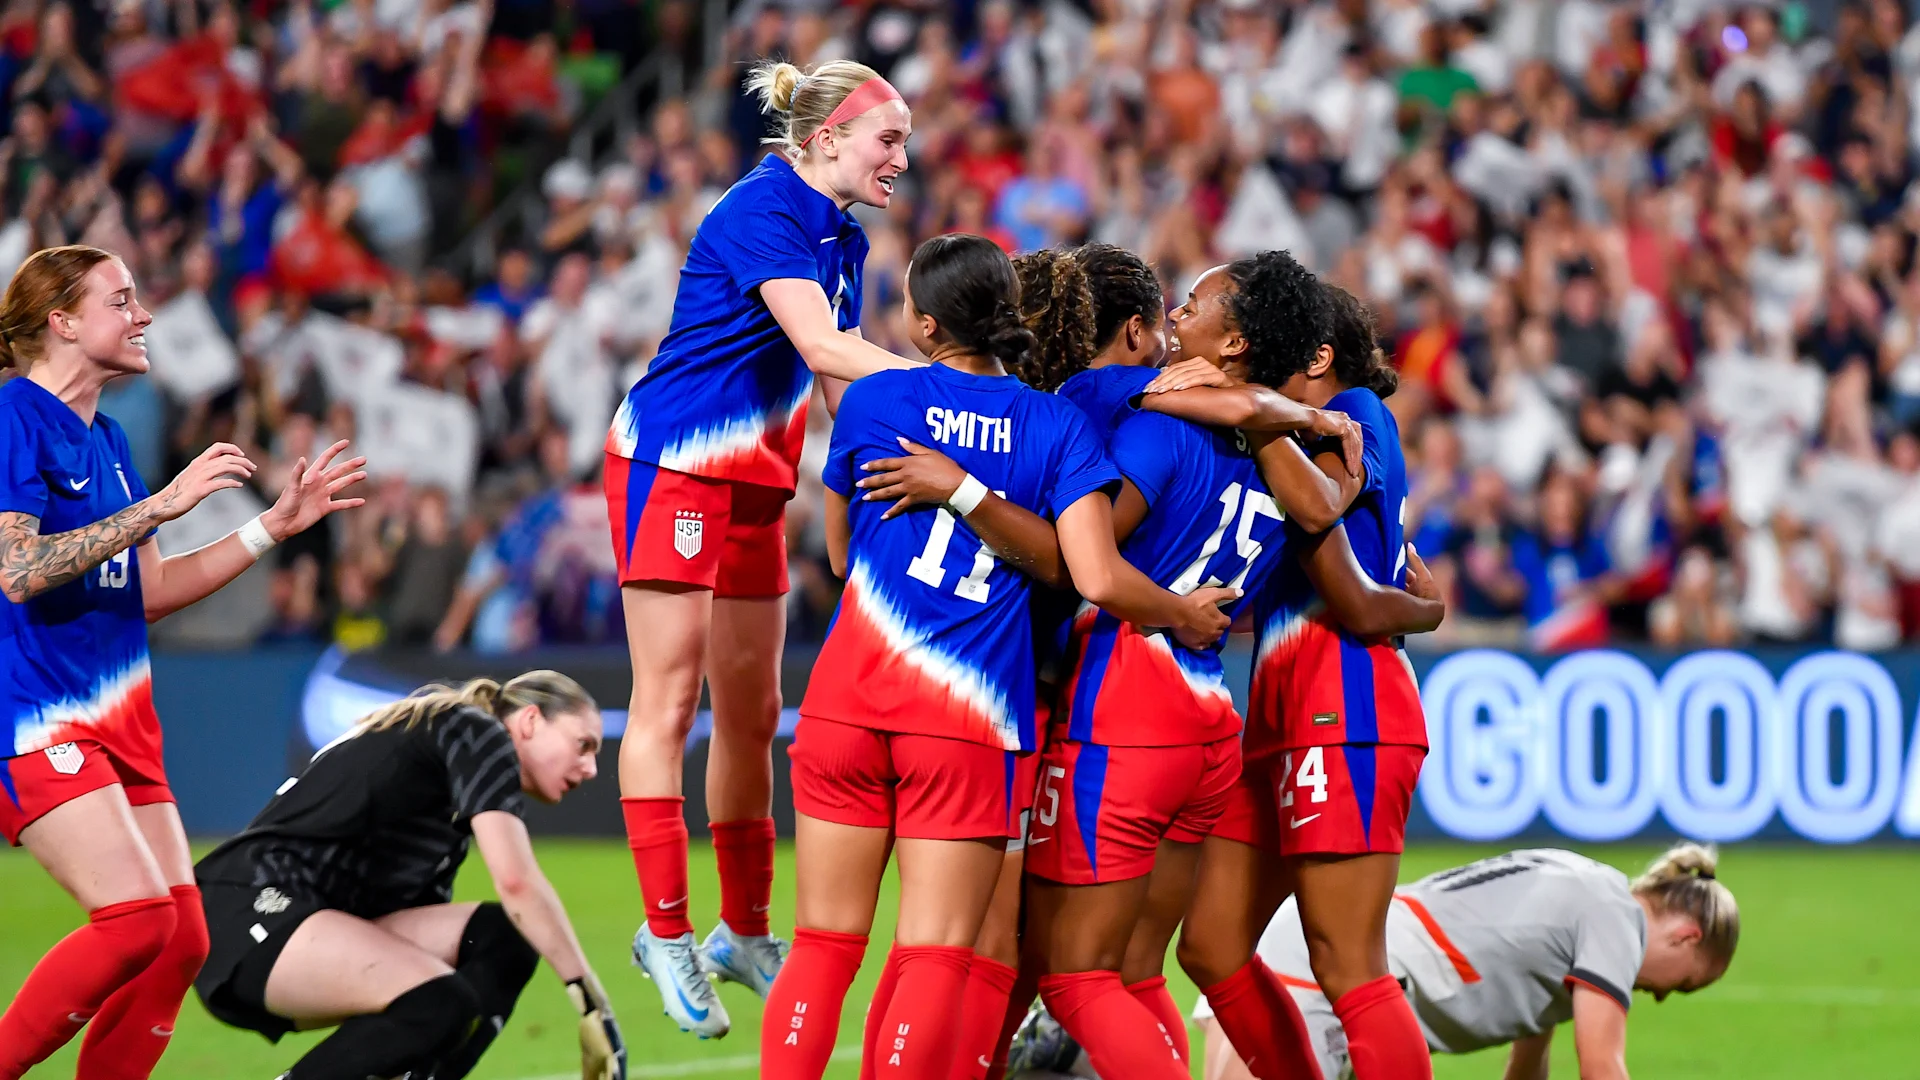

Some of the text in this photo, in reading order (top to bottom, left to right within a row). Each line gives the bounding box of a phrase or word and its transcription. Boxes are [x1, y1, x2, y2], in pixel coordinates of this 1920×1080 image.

[926, 406, 1011, 453] SMITH
[677, 521, 701, 536] USA
[1168, 482, 1286, 607] 15
[1419, 649, 1920, 844] GOOO
[785, 1001, 807, 1046] USA
[889, 1022, 910, 1067] USA
